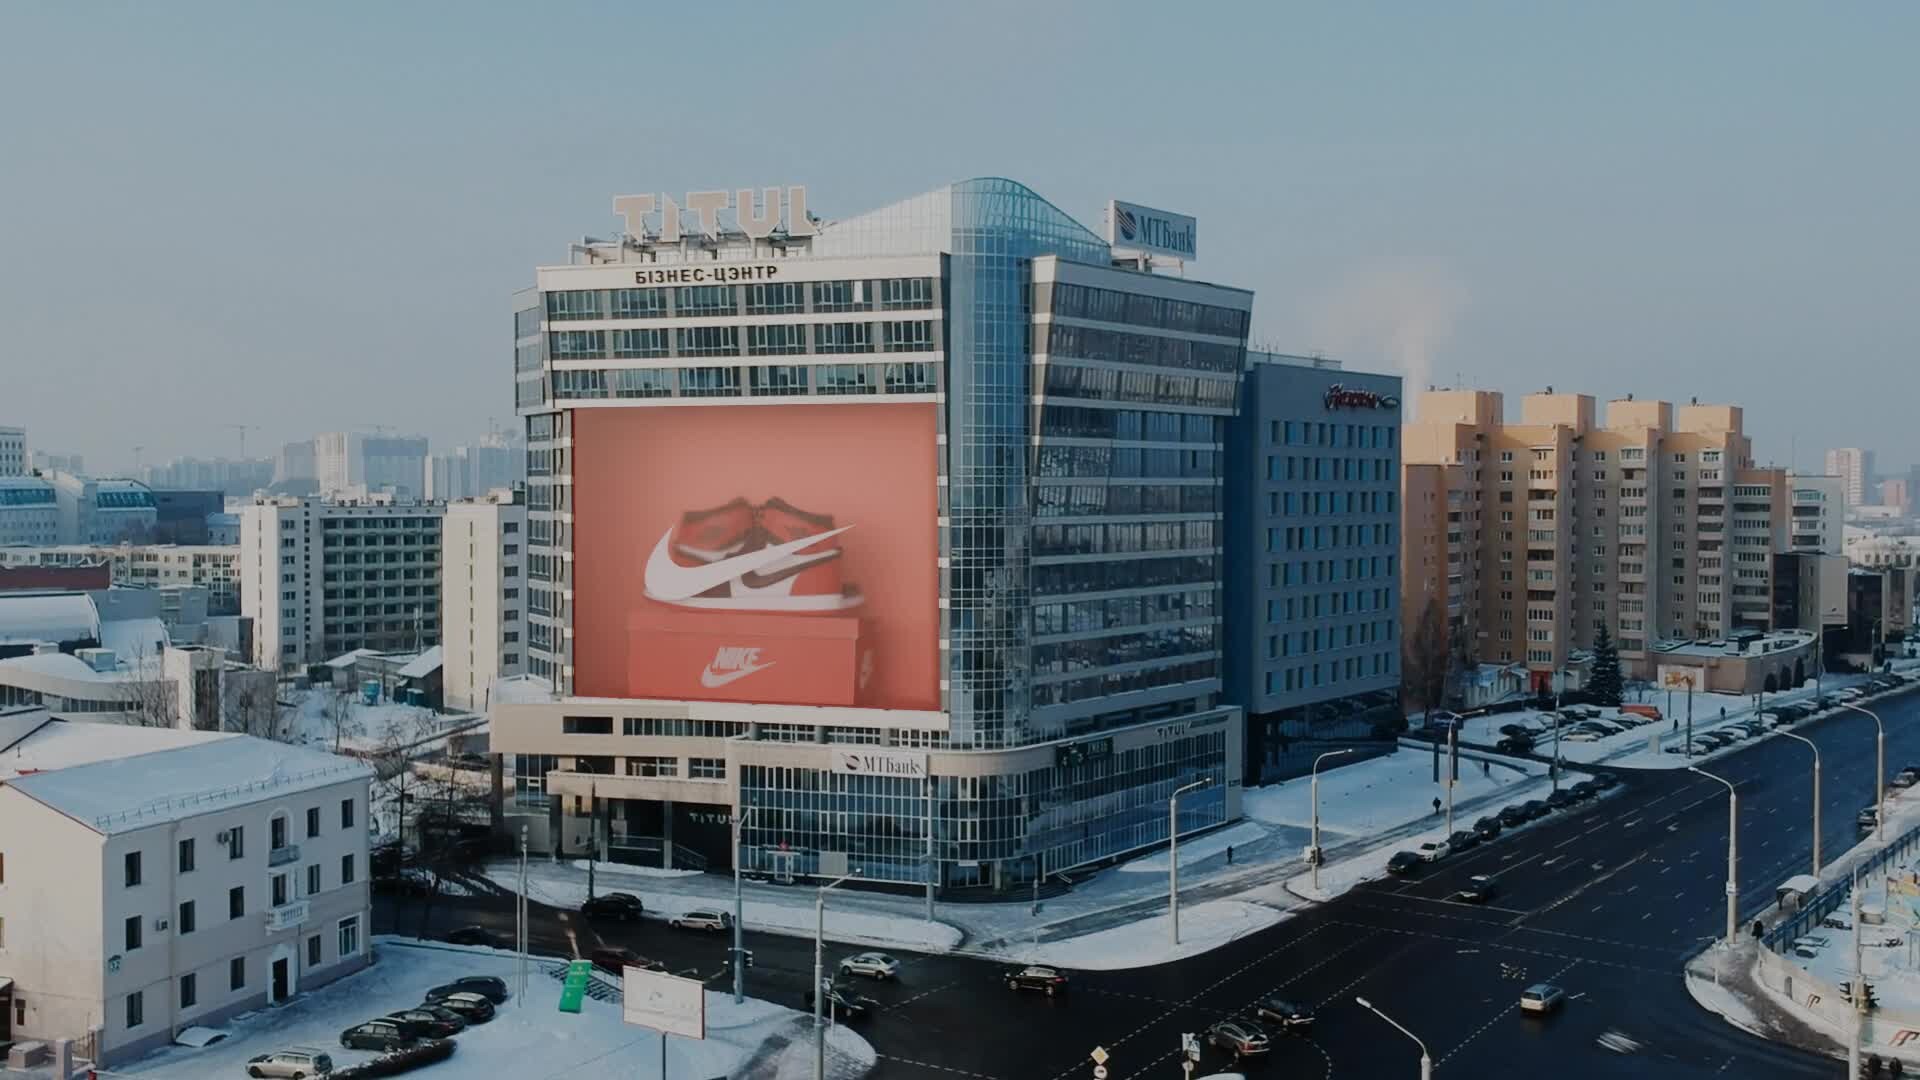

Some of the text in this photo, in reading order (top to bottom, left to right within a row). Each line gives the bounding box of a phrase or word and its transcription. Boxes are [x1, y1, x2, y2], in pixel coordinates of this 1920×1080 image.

[614, 185, 817, 241] TITUL
[635, 265, 777, 283] БІЗНЕС-ЦЭНТР
[712, 647, 765, 670] NIKE
